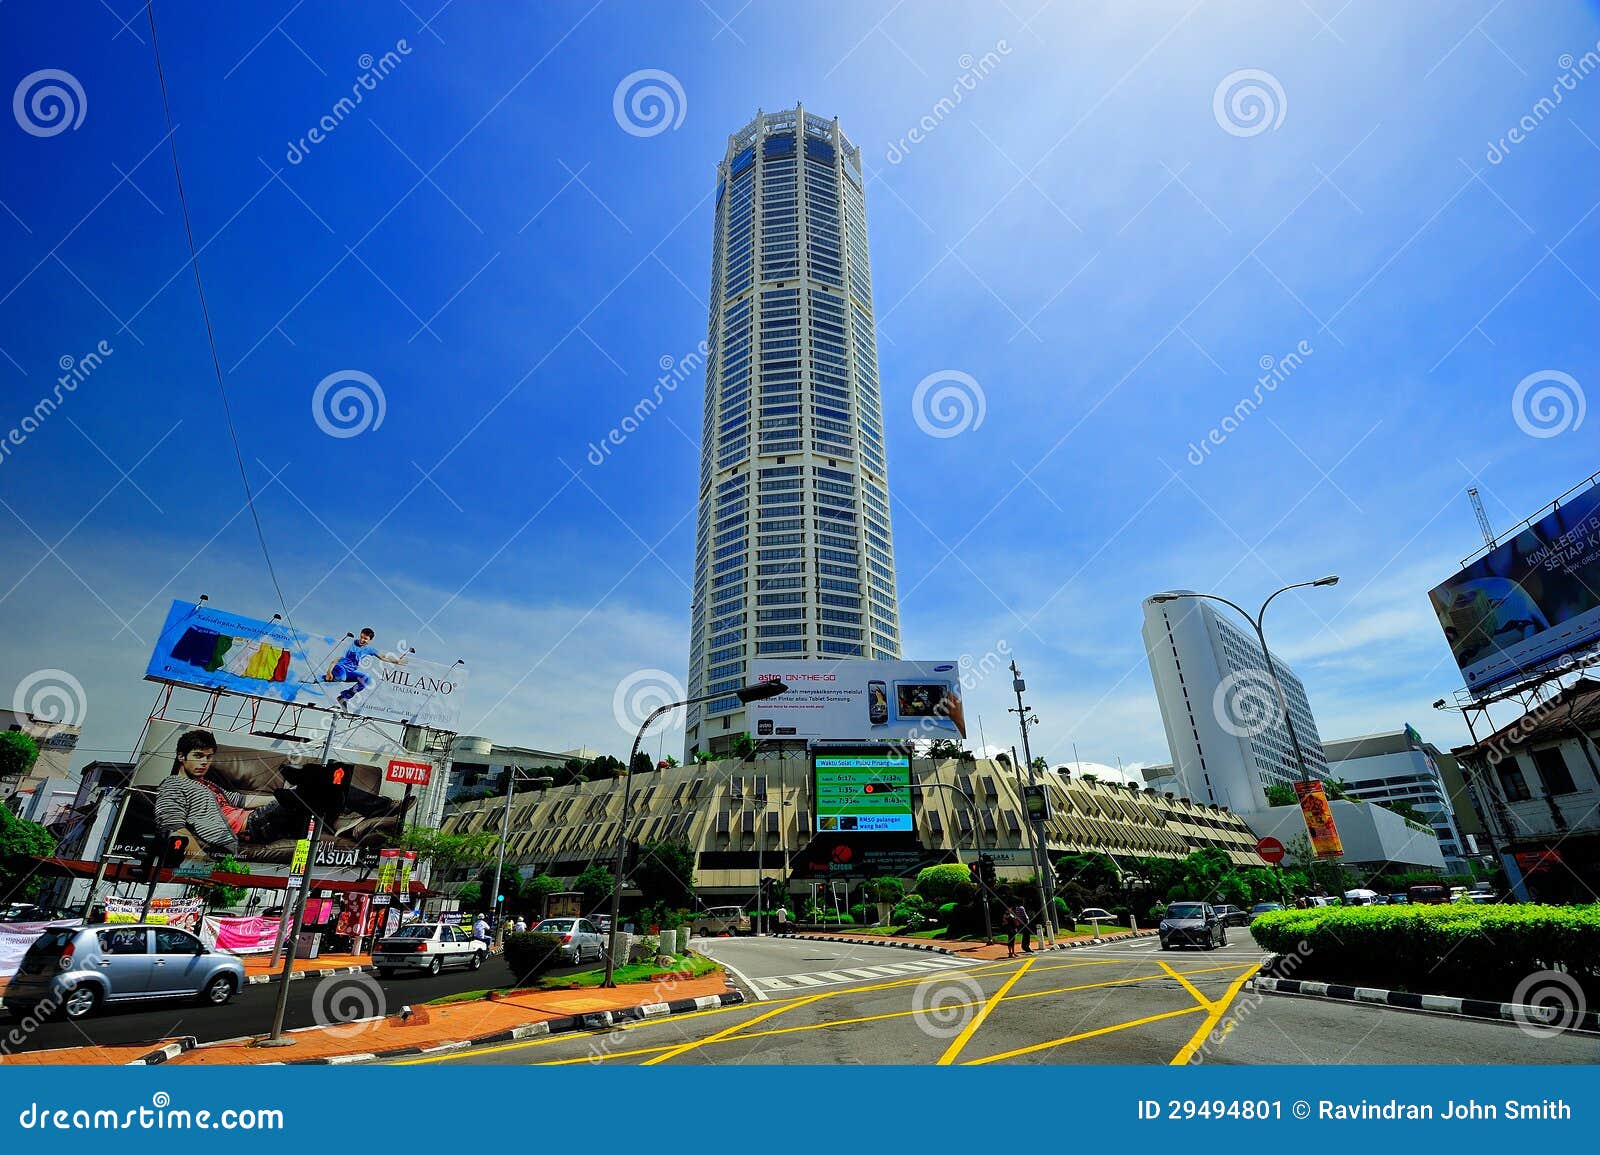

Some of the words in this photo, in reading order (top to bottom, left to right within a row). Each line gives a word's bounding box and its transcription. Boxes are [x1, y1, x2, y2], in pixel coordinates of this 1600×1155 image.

[1526, 546, 1550, 566] KINI
[1552, 523, 1589, 551] LEBIH
[1544, 541, 1585, 571] SETIAP
[381, 668, 453, 695] MILANO
[758, 674, 781, 682] astro
[391, 765, 426, 781] EDWIN
